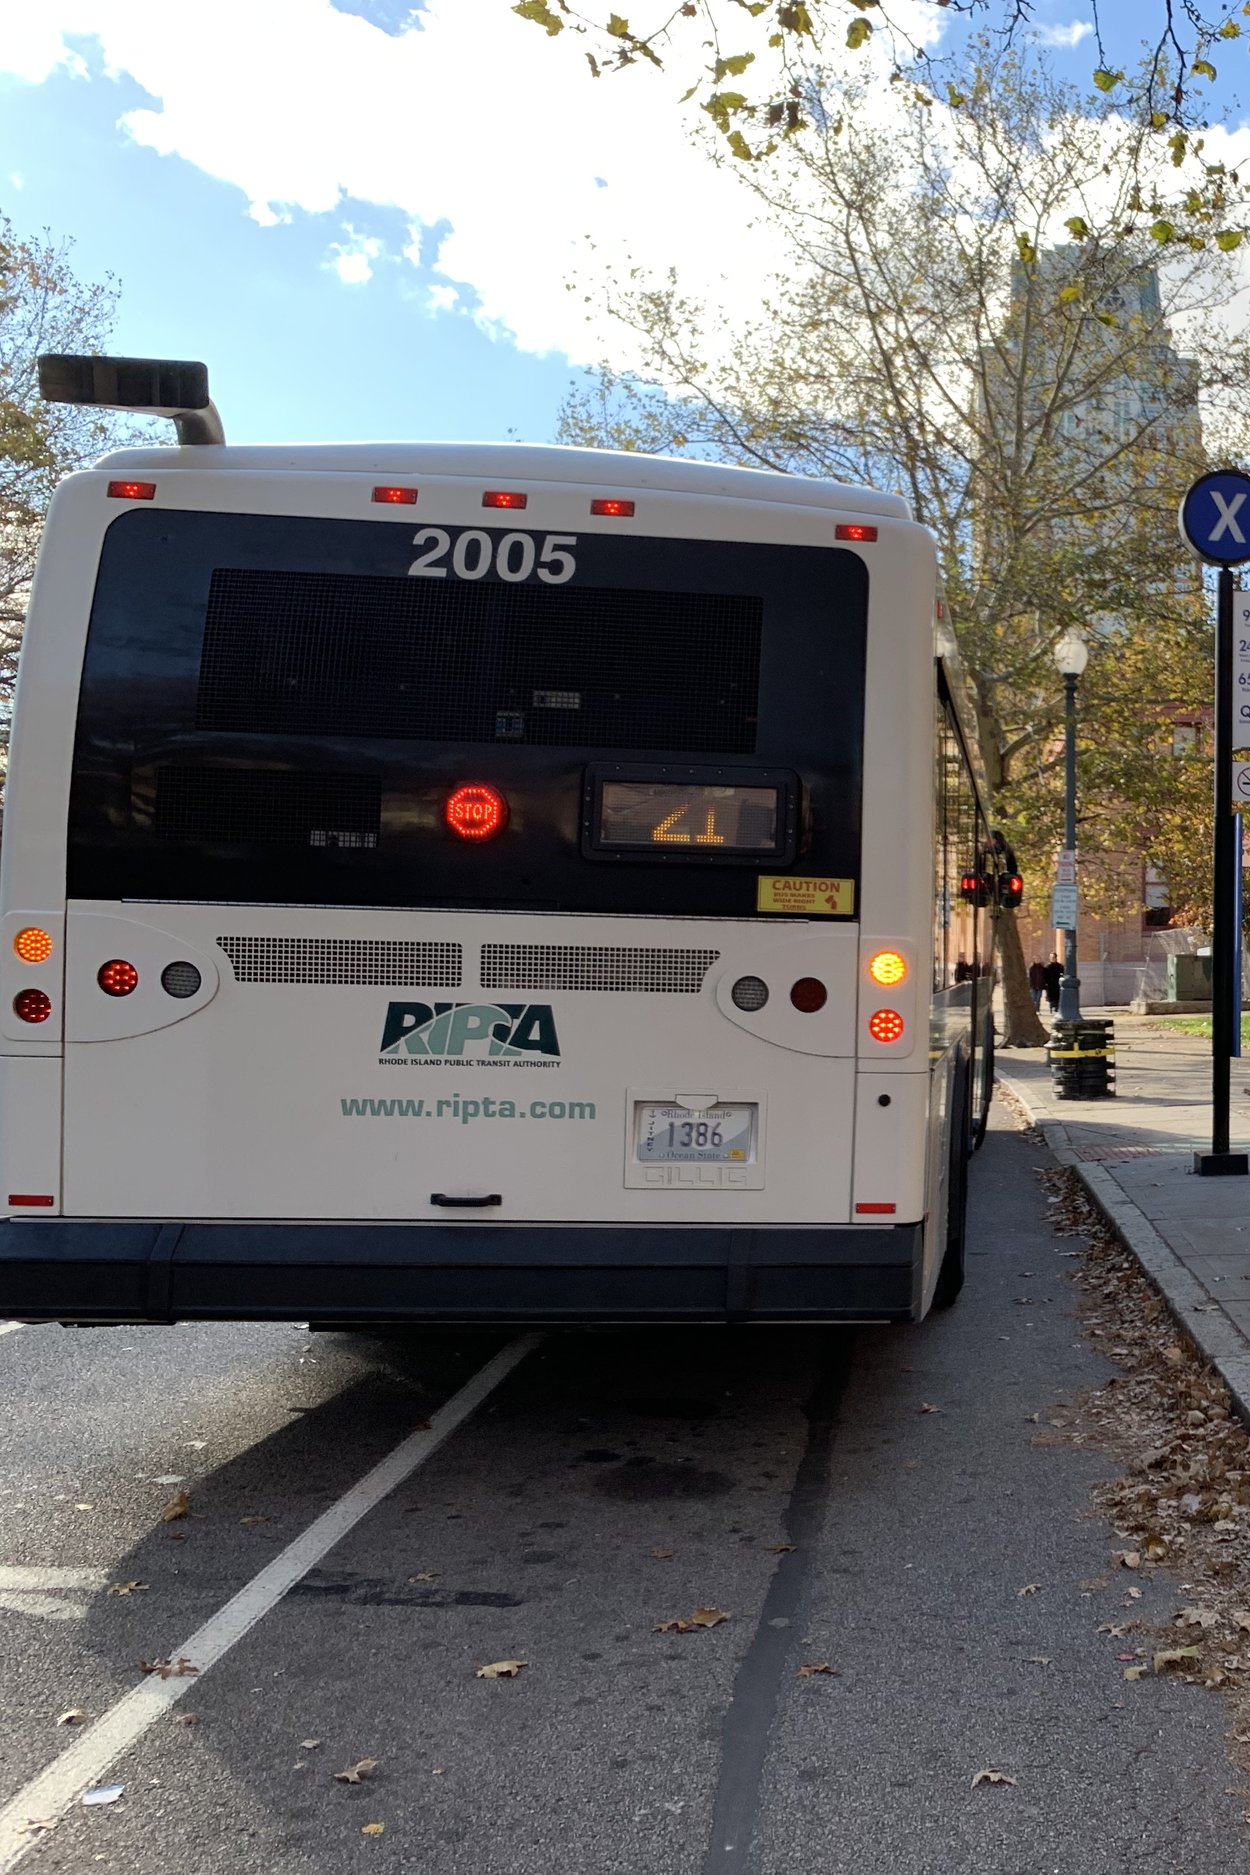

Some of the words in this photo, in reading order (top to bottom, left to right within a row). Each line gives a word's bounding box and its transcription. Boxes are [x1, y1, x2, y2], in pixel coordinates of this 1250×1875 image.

[1208, 490, 1247, 544] X
[407, 527, 577, 584] 2005
[455, 803, 493, 819] STOP
[772, 880, 840, 893] CAUTION
[380, 1001, 561, 1056] RIPTA
[378, 1058, 409, 1066] RHODE
[410, 1058, 442, 1066] ISLAND
[444, 1059, 474, 1067] PUBLIC
[476, 1060, 511, 1068] TRANSIT
[513, 1060, 562, 1069] AUTHORITY
[340, 1093, 596, 1124] www.ripta.com
[668, 1121, 723, 1147] 1386
[667, 1151, 695, 1159] Ocean
[698, 1151, 720, 1159] State
[643, 1166, 748, 1185] GILLIG
